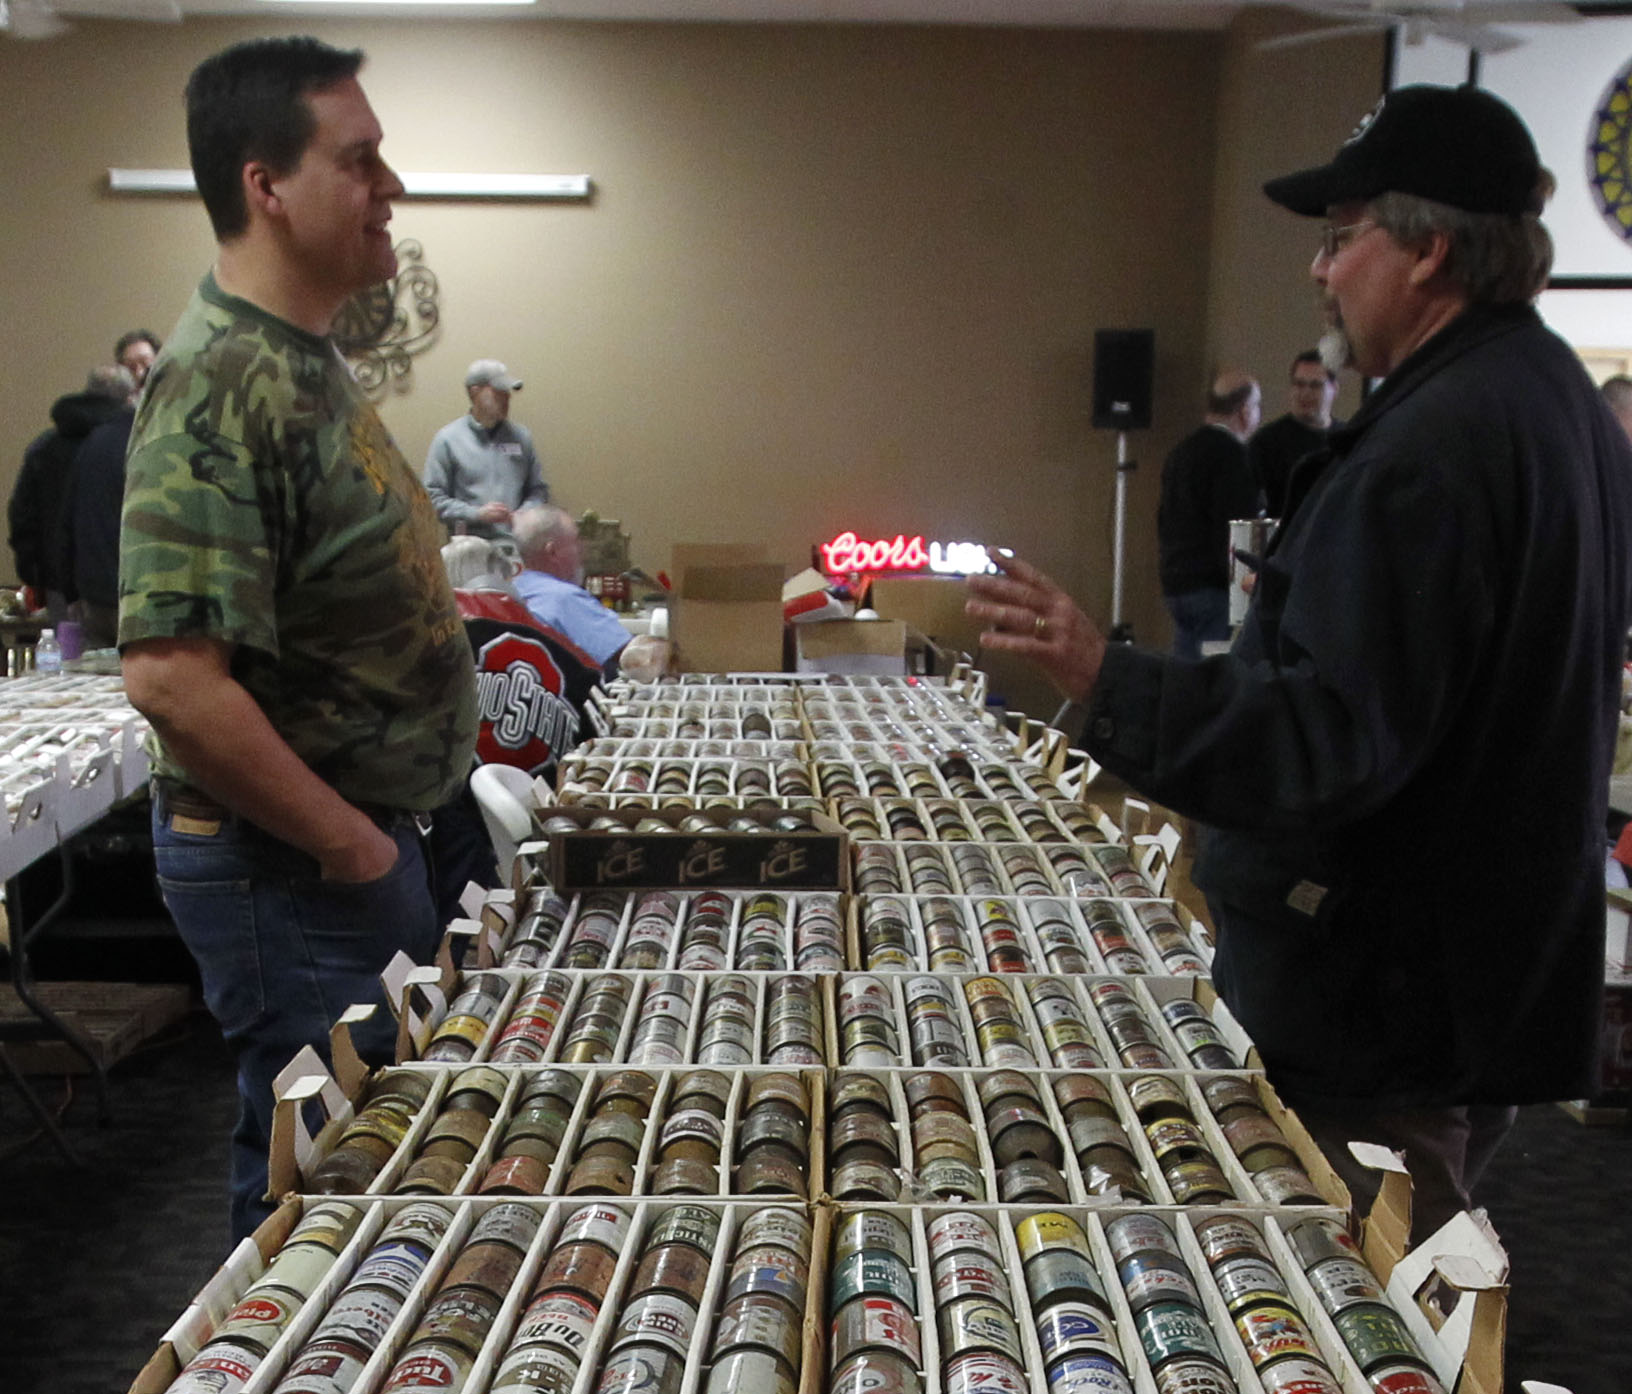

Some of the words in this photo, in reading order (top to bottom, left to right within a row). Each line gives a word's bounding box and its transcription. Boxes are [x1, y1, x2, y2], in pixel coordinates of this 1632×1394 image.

[820, 531, 930, 575] Coors
[679, 847, 727, 884] ICE
[760, 848, 808, 883] ICE
